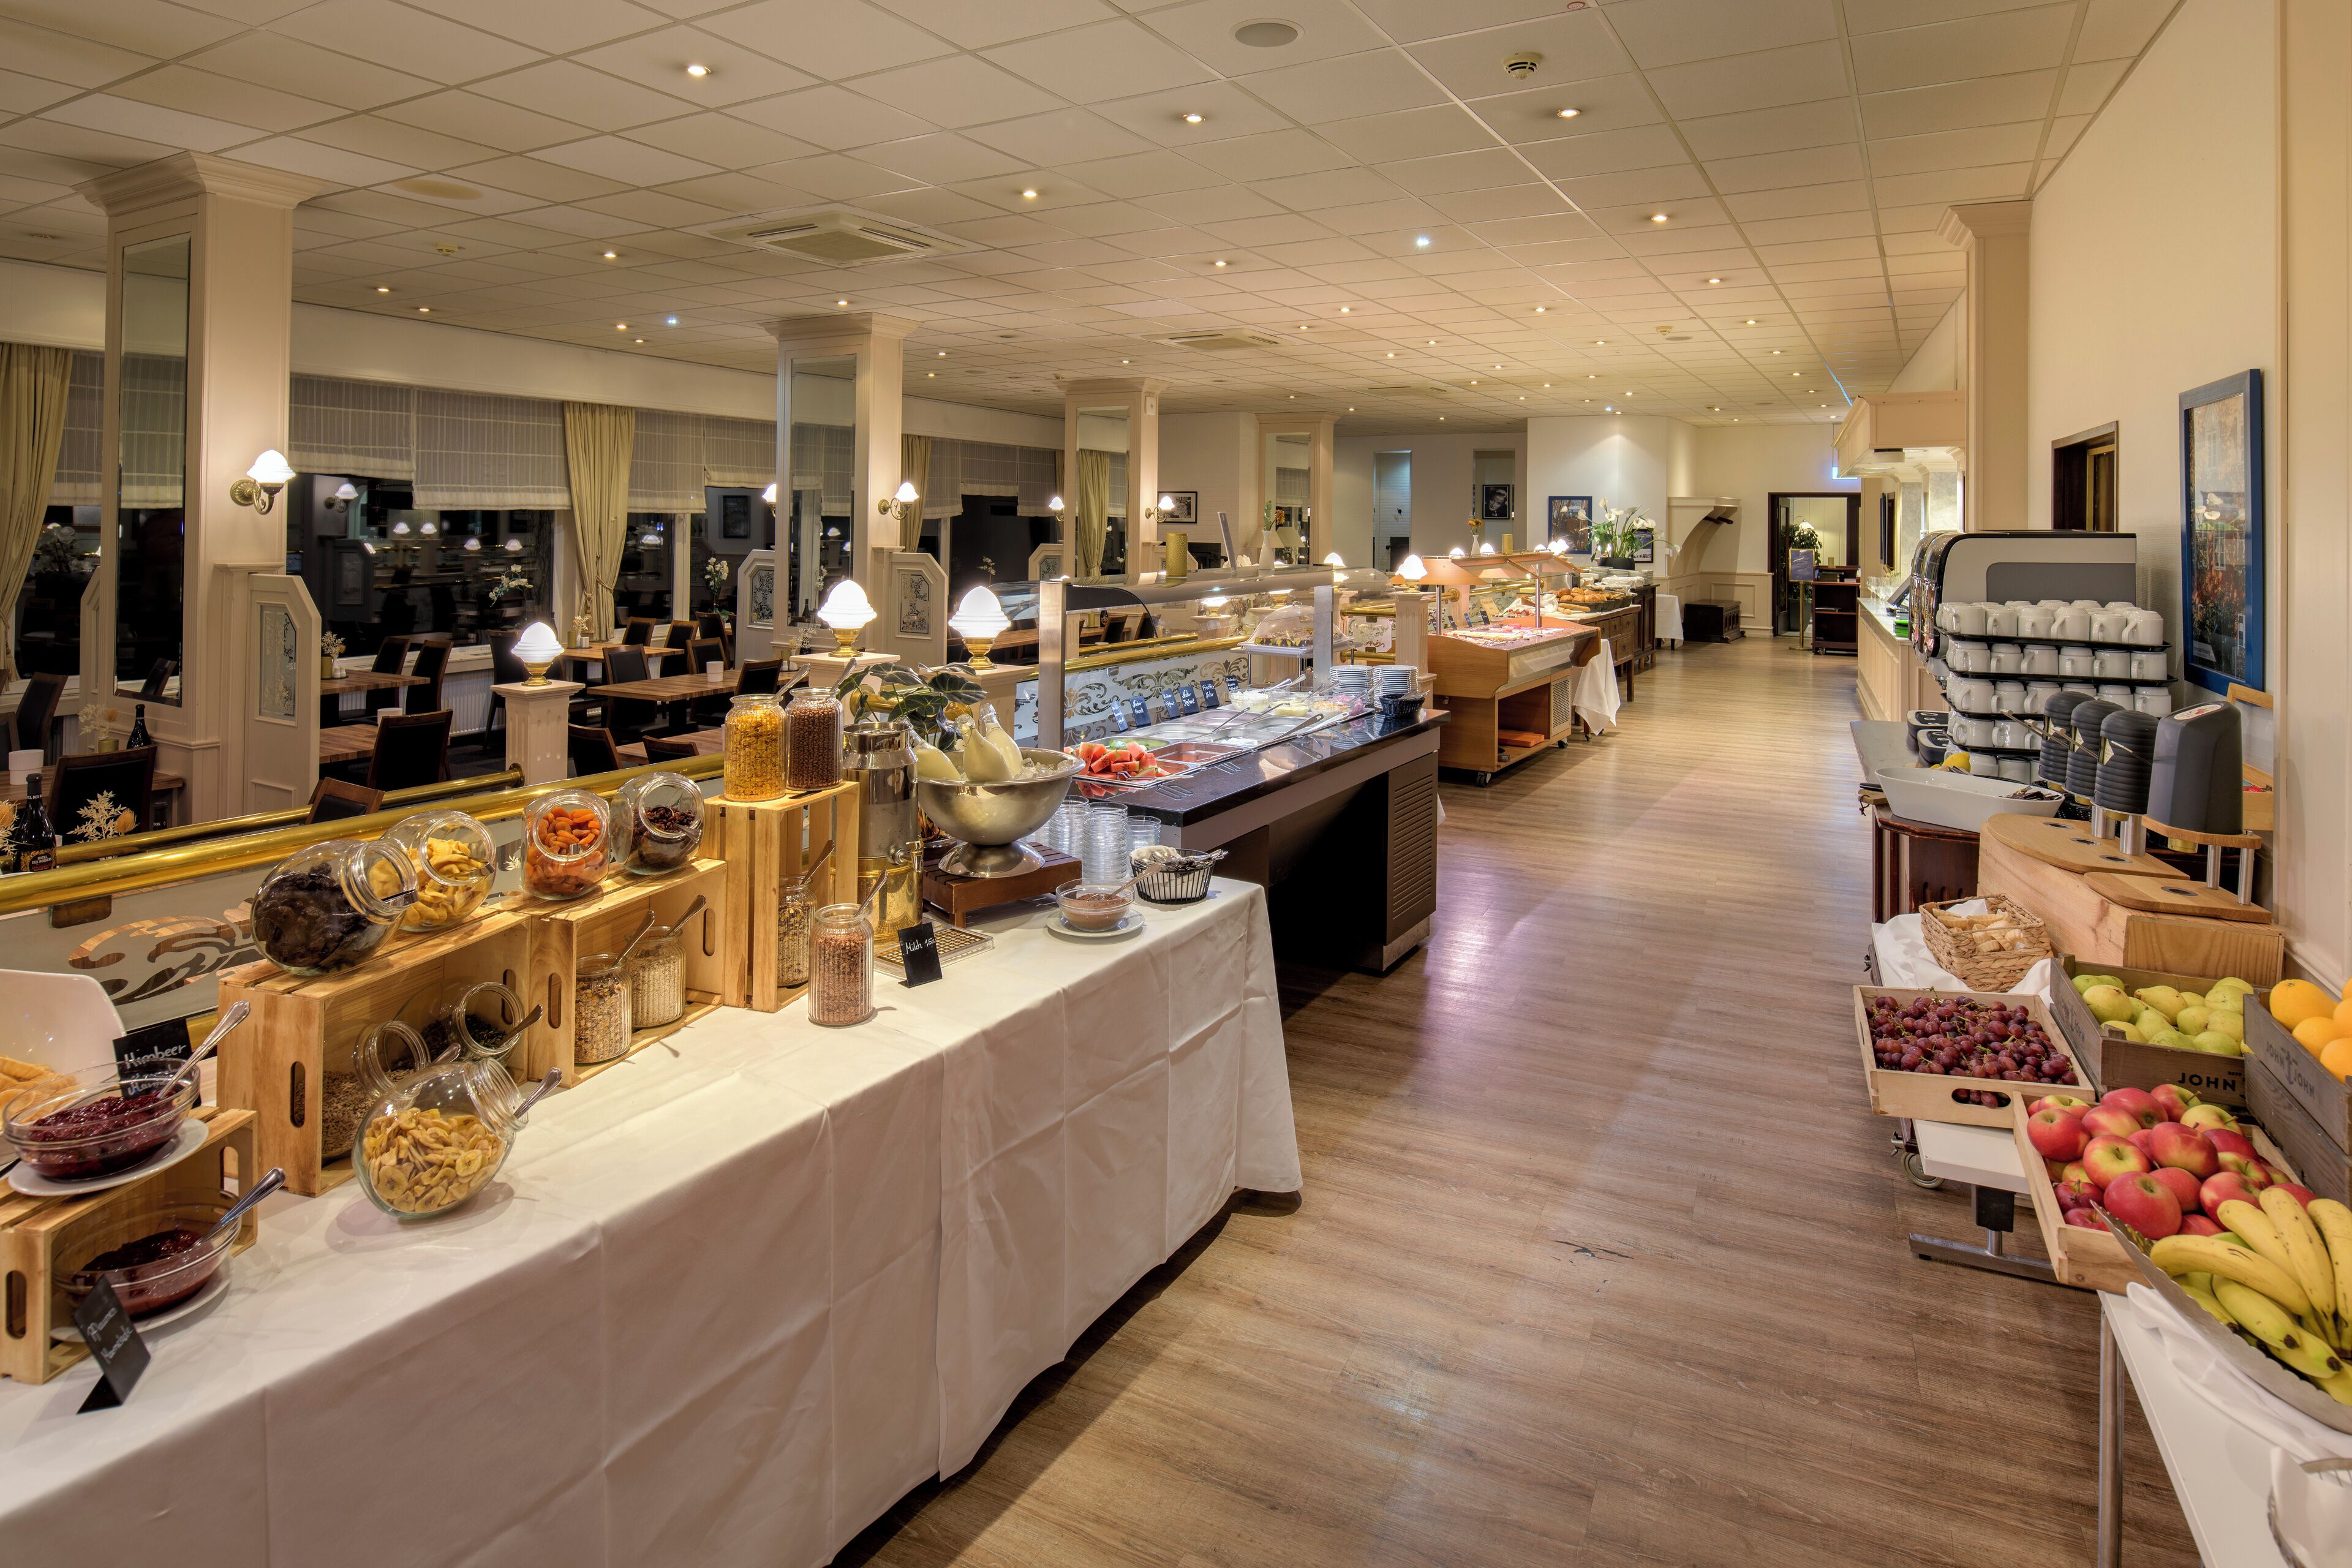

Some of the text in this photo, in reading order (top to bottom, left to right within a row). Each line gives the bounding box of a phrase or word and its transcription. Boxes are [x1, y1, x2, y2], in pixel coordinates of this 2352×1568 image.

[905, 939, 923, 955] Milch
[124, 1044, 186, 1069] Himbeer
[2266, 1041, 2315, 1099] JOHN JOHN
[2177, 1072, 2236, 1092] JOHN
